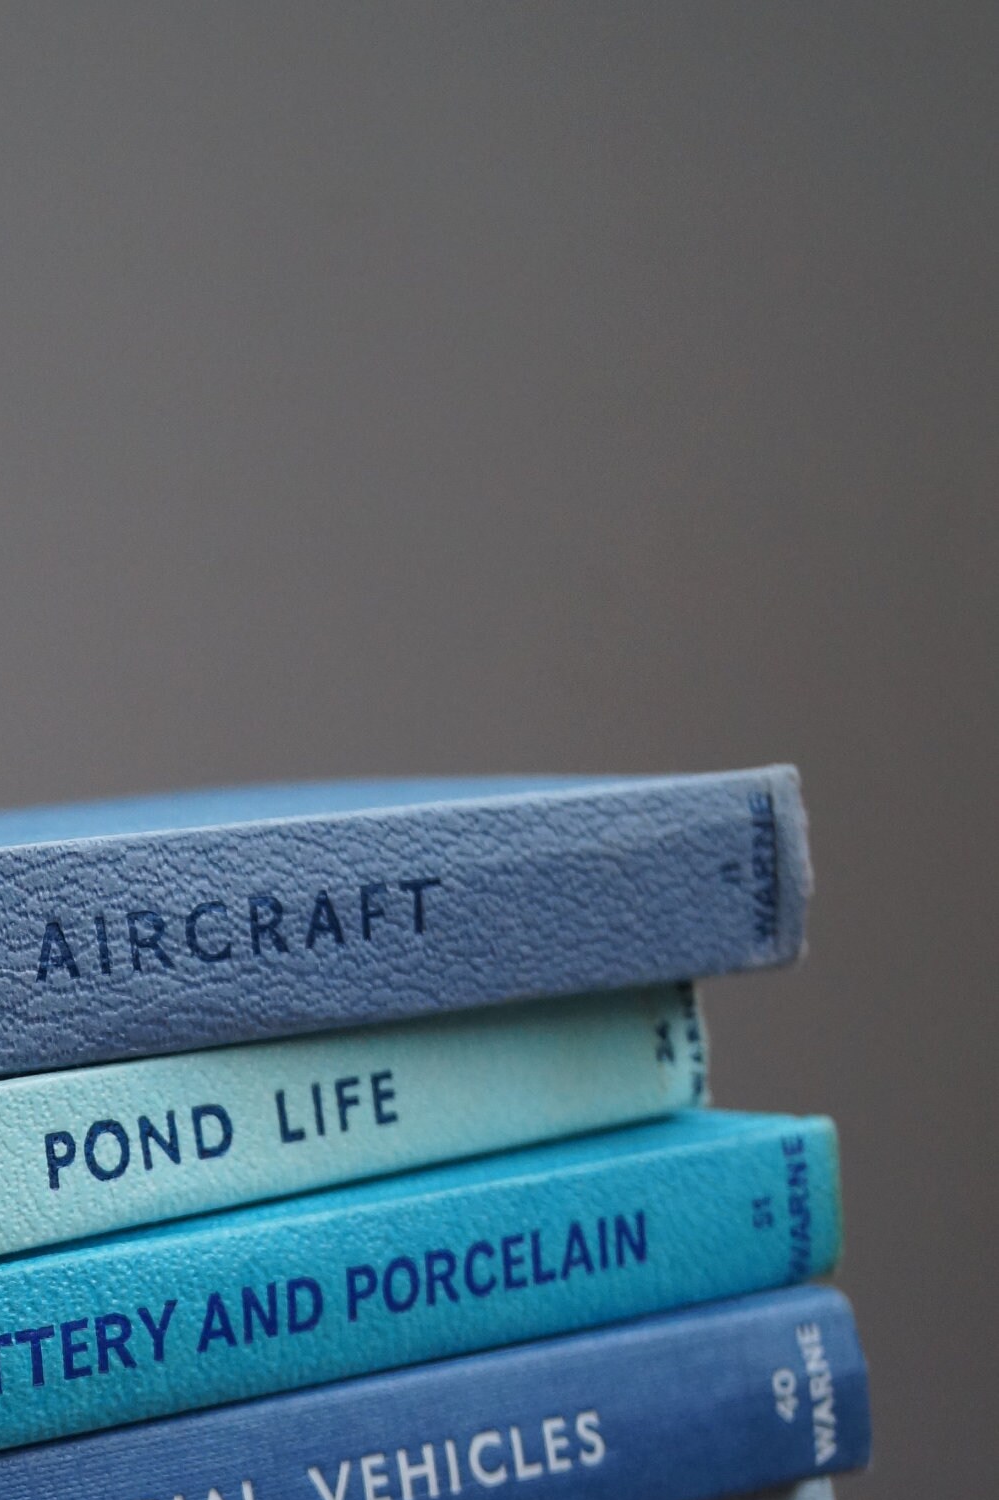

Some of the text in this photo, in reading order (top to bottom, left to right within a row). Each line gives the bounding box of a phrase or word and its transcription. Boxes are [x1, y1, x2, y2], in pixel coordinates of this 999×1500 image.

[36, 878, 440, 983] AIRCRAFT
[45, 1069, 398, 1190] POND LIFE
[197, 1277, 324, 1352] AND
[344, 1210, 648, 1321] PORCELAIN
[771, 1367, 799, 1424] 40
[795, 1321, 837, 1466] WARNE
